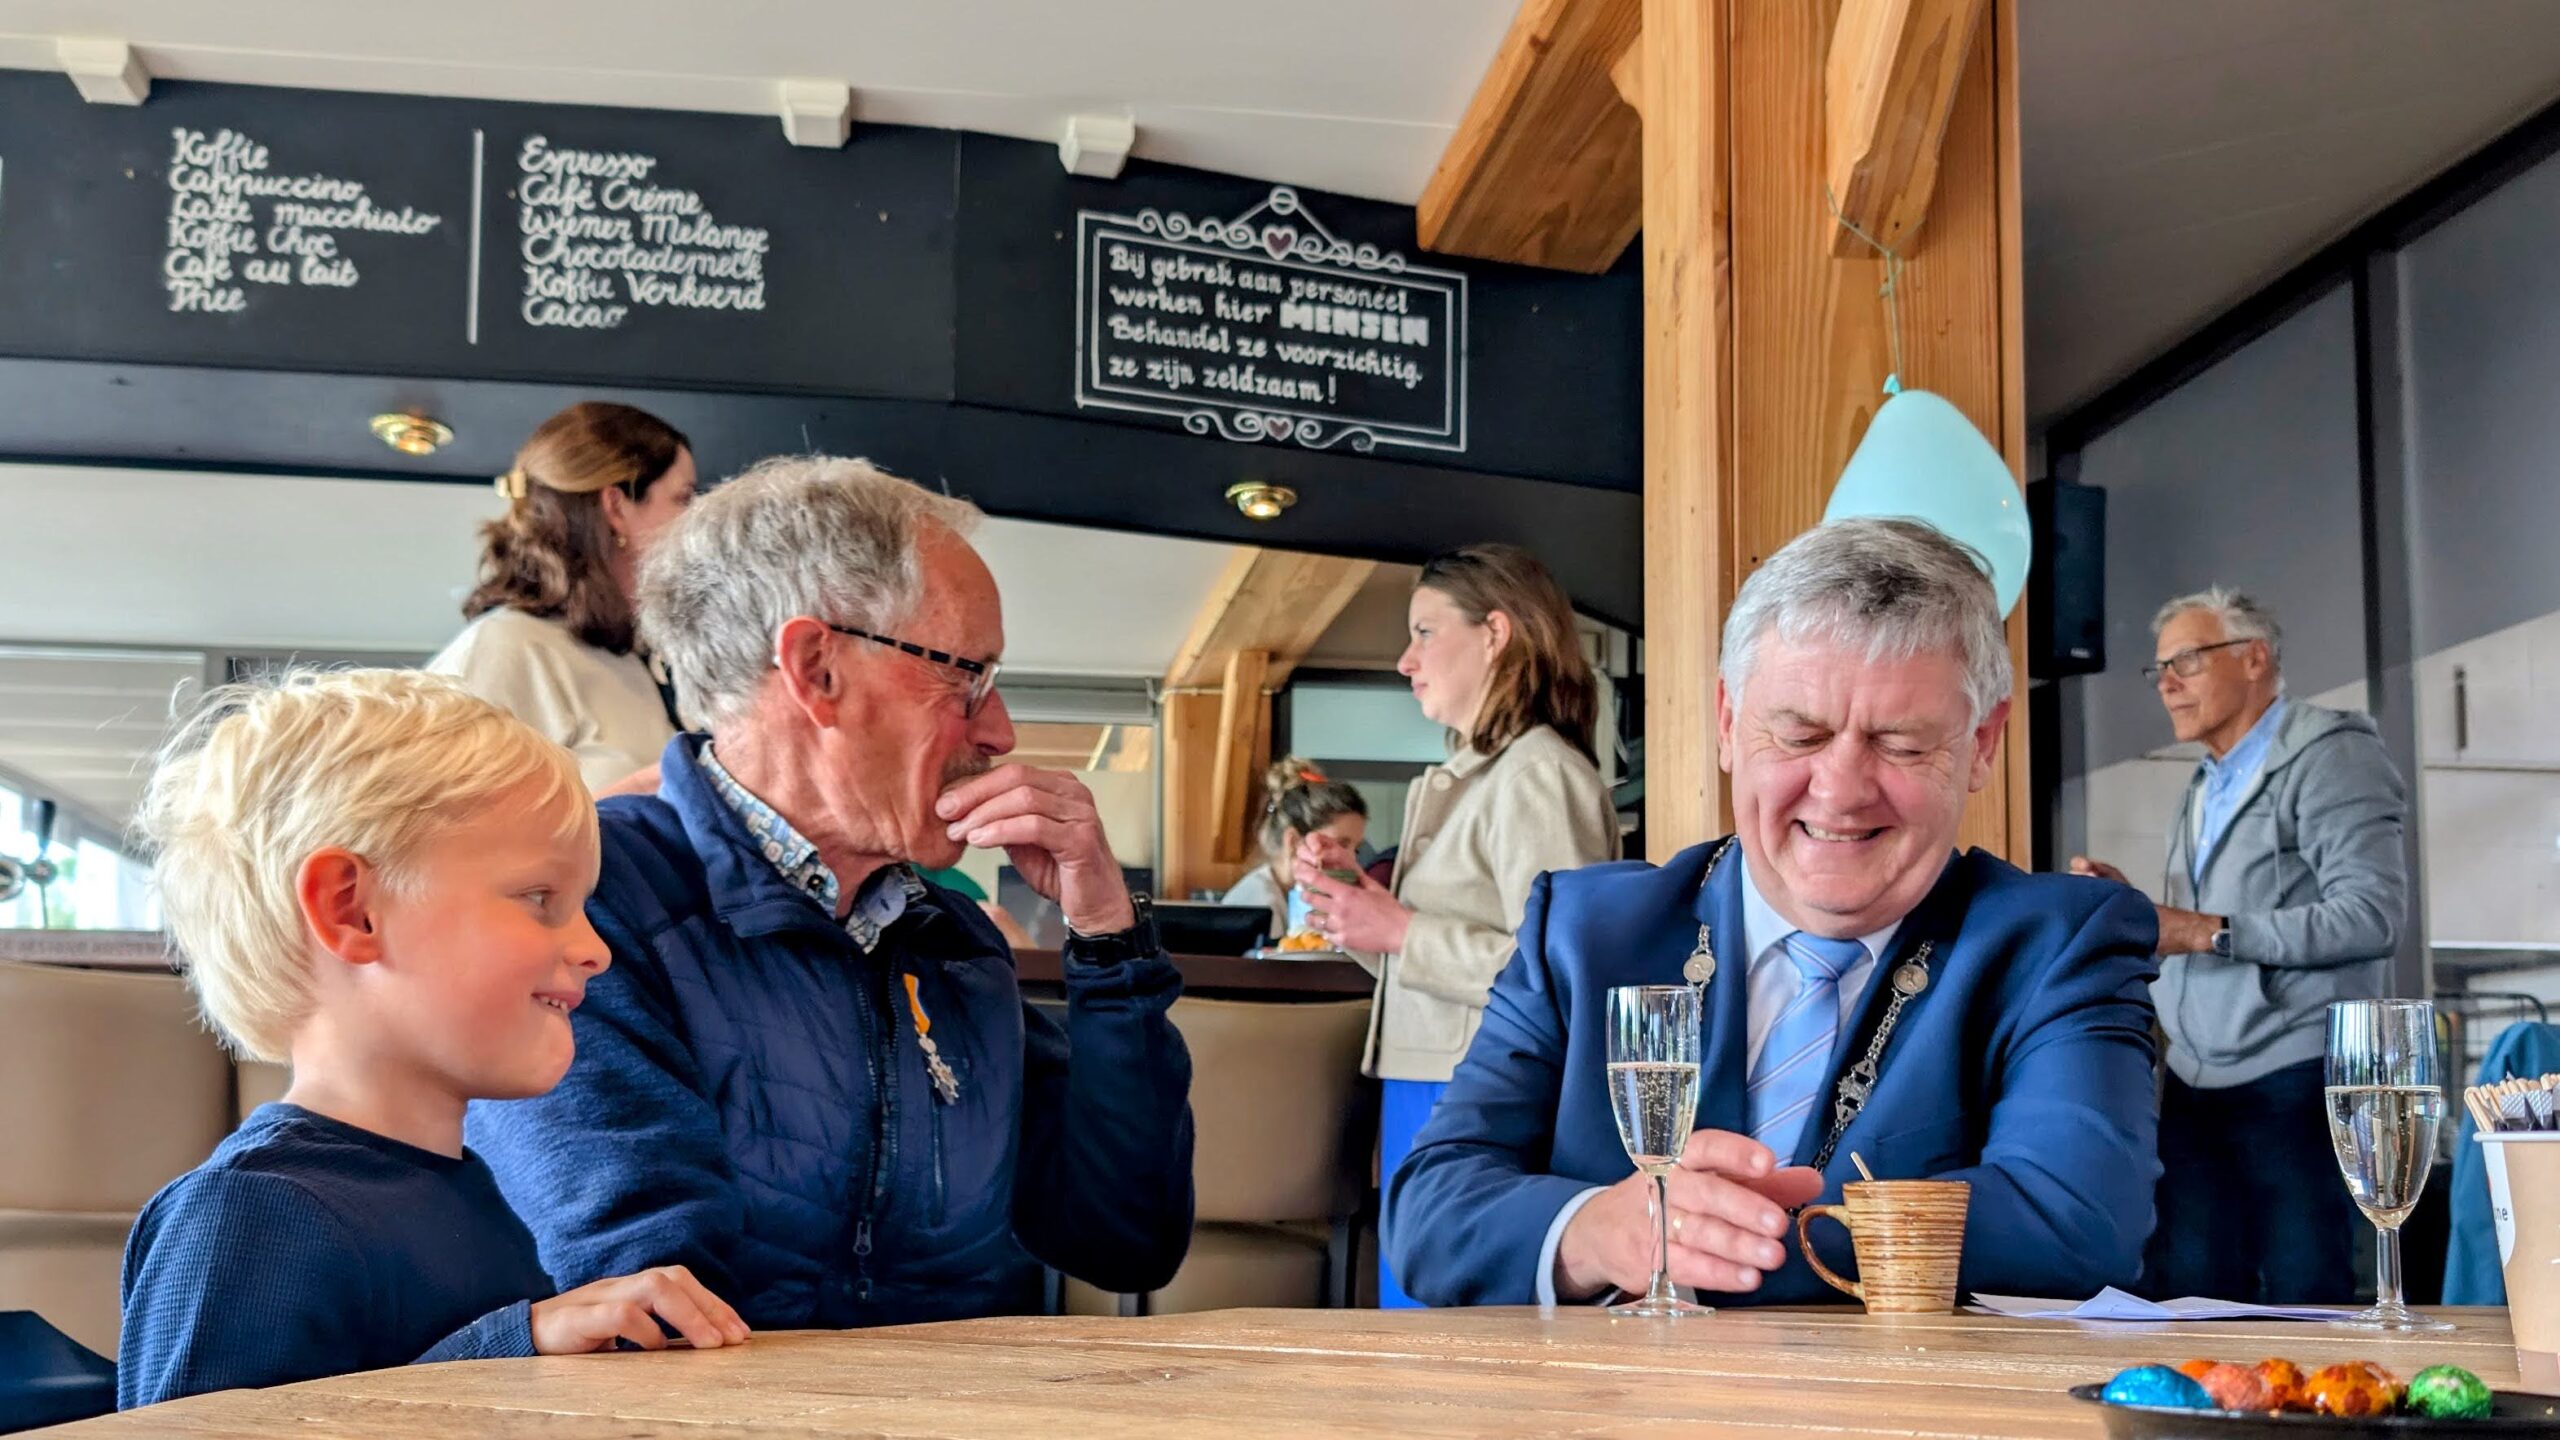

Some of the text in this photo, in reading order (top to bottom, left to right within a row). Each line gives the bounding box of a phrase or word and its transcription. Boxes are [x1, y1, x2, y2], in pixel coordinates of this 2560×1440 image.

[172, 127, 269, 175] Koffie
[519, 135, 656, 182] Espresso
[168, 164, 364, 203] Cappuccino
[519, 174, 596, 215] Café
[172, 192, 441, 234] Latte macchiato
[519, 206, 769, 256] Wiener Melange
[168, 216, 337, 258] Koffie Choc
[522, 234, 764, 280] Chocolademelk
[244, 259, 290, 285] au
[522, 264, 766, 310] Koffie Verkeerd
[1109, 244, 1408, 315] Bij gebrek aan personeel
[166, 279, 247, 311] Thee
[522, 296, 628, 328] Cacao
[1109, 284, 1430, 347] werken hier MENSEN
[1107, 313, 1424, 389] Behandel ze voorzichtig.
[1108, 354, 1139, 378] ze
[1146, 355, 1196, 390] zijn
